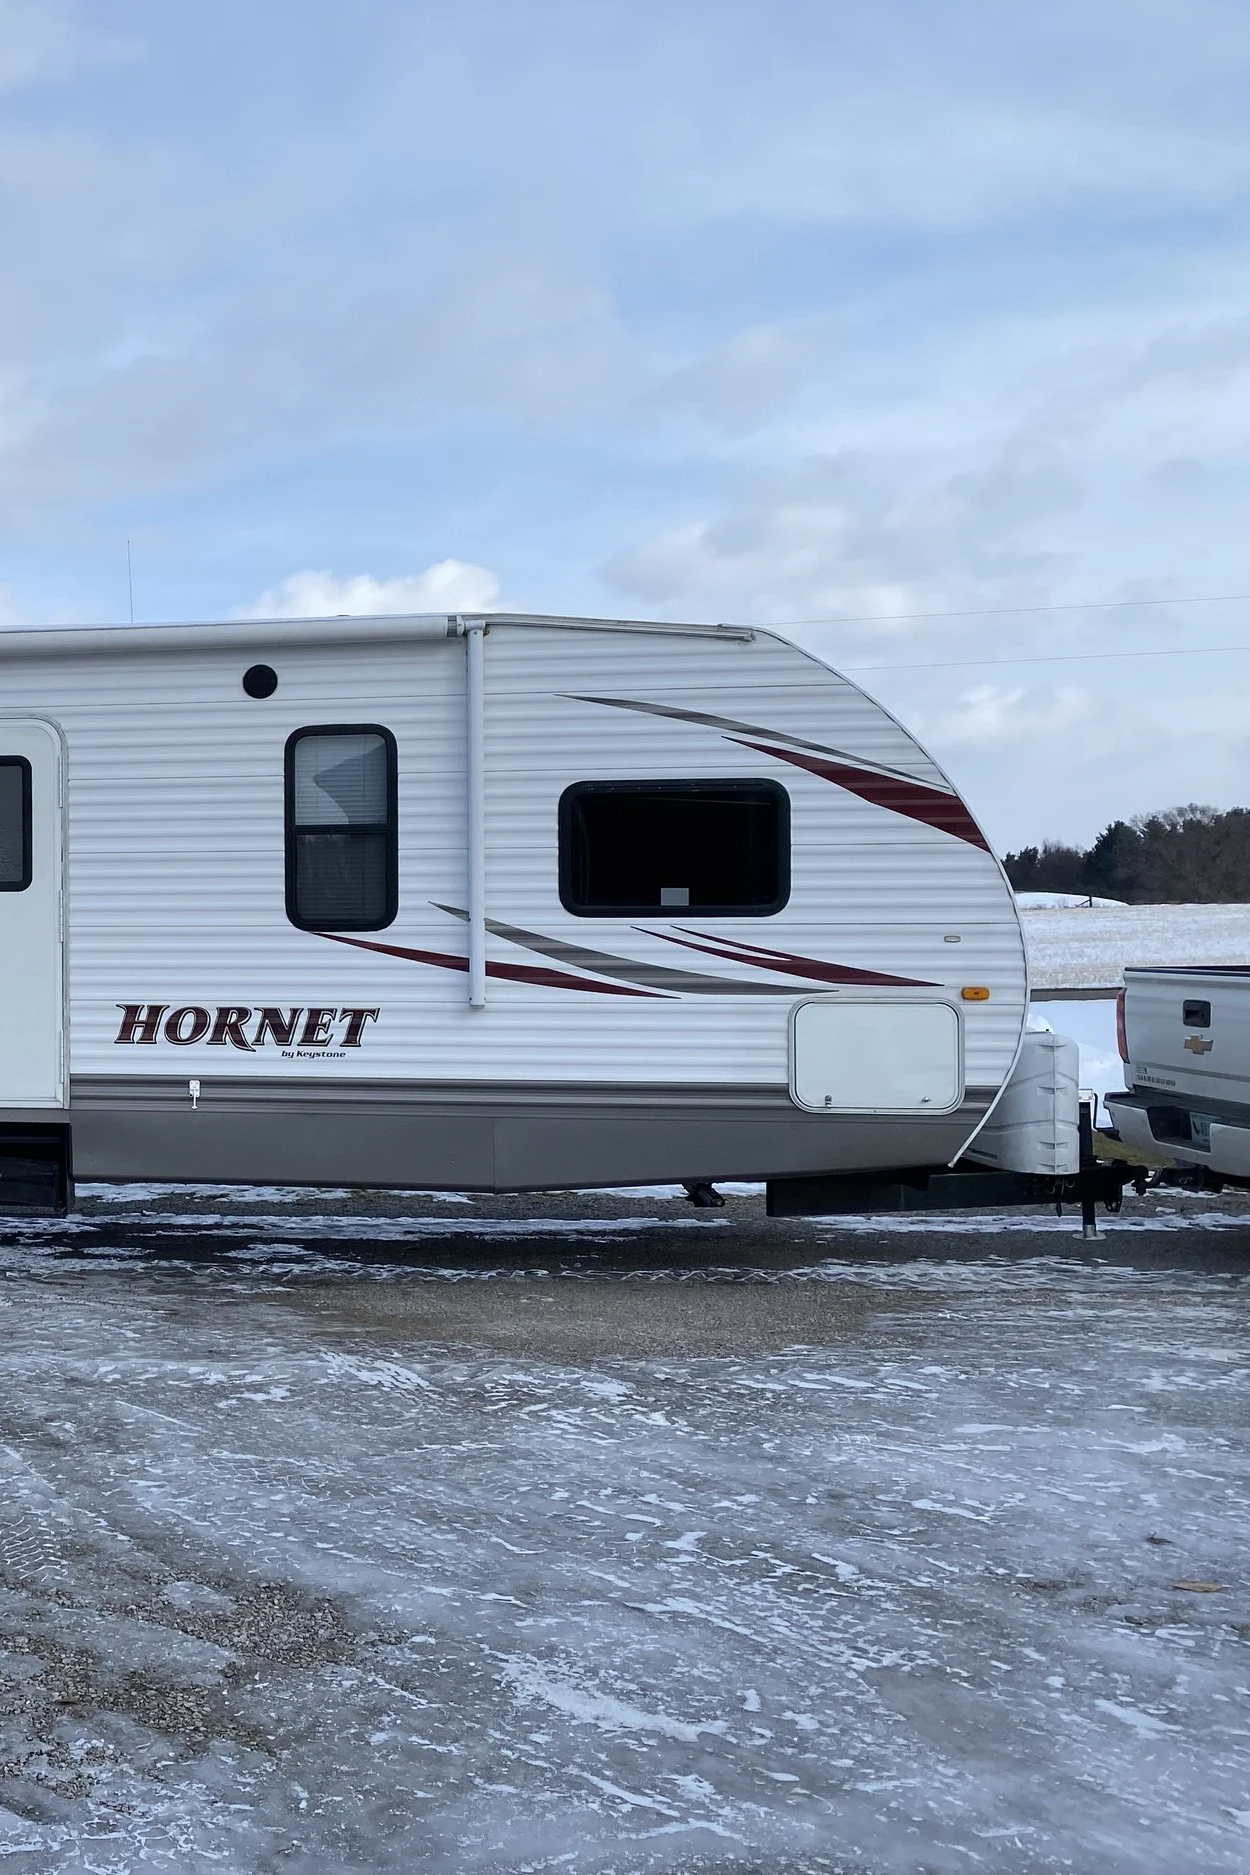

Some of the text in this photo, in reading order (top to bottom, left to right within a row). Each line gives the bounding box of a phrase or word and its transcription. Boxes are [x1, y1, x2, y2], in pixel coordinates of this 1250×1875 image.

[114, 1004, 381, 1052] HORNET
[281, 1050, 346, 1059] by Keystone
